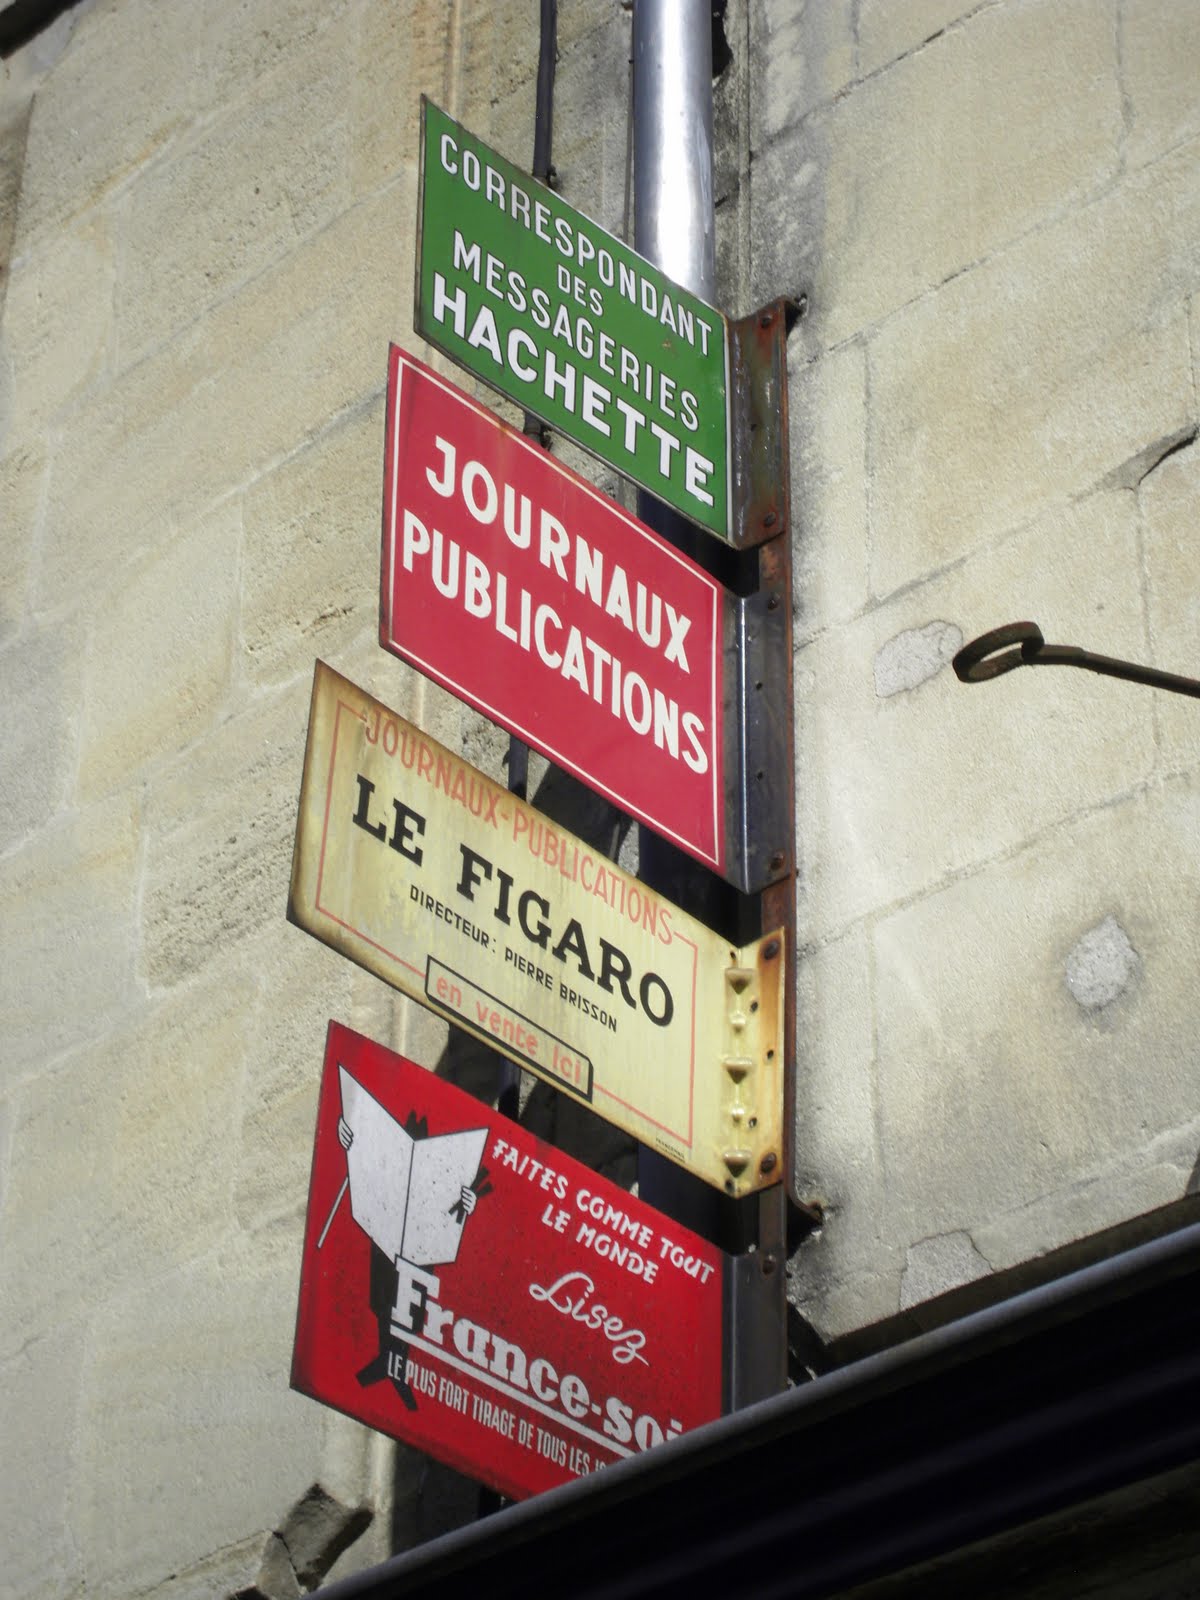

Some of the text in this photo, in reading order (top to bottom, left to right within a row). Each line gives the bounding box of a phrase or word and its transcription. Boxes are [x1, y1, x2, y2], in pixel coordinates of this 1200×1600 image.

[440, 133, 712, 356] CORRESPONDANT
[453, 229, 699, 432] MESSAGERIES
[557, 263, 603, 317] DES
[433, 272, 714, 507] HACHETTE
[425, 435, 692, 674] JOURNAUX
[403, 508, 709, 776] PUBLICATIONS
[352, 773, 674, 1028] LE FIGARO
[365, 710, 674, 946] JOURNAUX-PUBLICATIONS
[436, 975, 462, 1008] en
[476, 1000, 538, 1055] vente
[505, 946, 554, 991] PIERRE
[559, 982, 618, 1033] BRISSON
[492, 1139, 715, 1284] FAITES COMME TOUT
[541, 1204, 659, 1284] LE MONDE
[529, 1271, 650, 1367] Lisez
[387, 1351, 591, 1477] LE PLUS FORT TIRAGE DE TOUS LES
